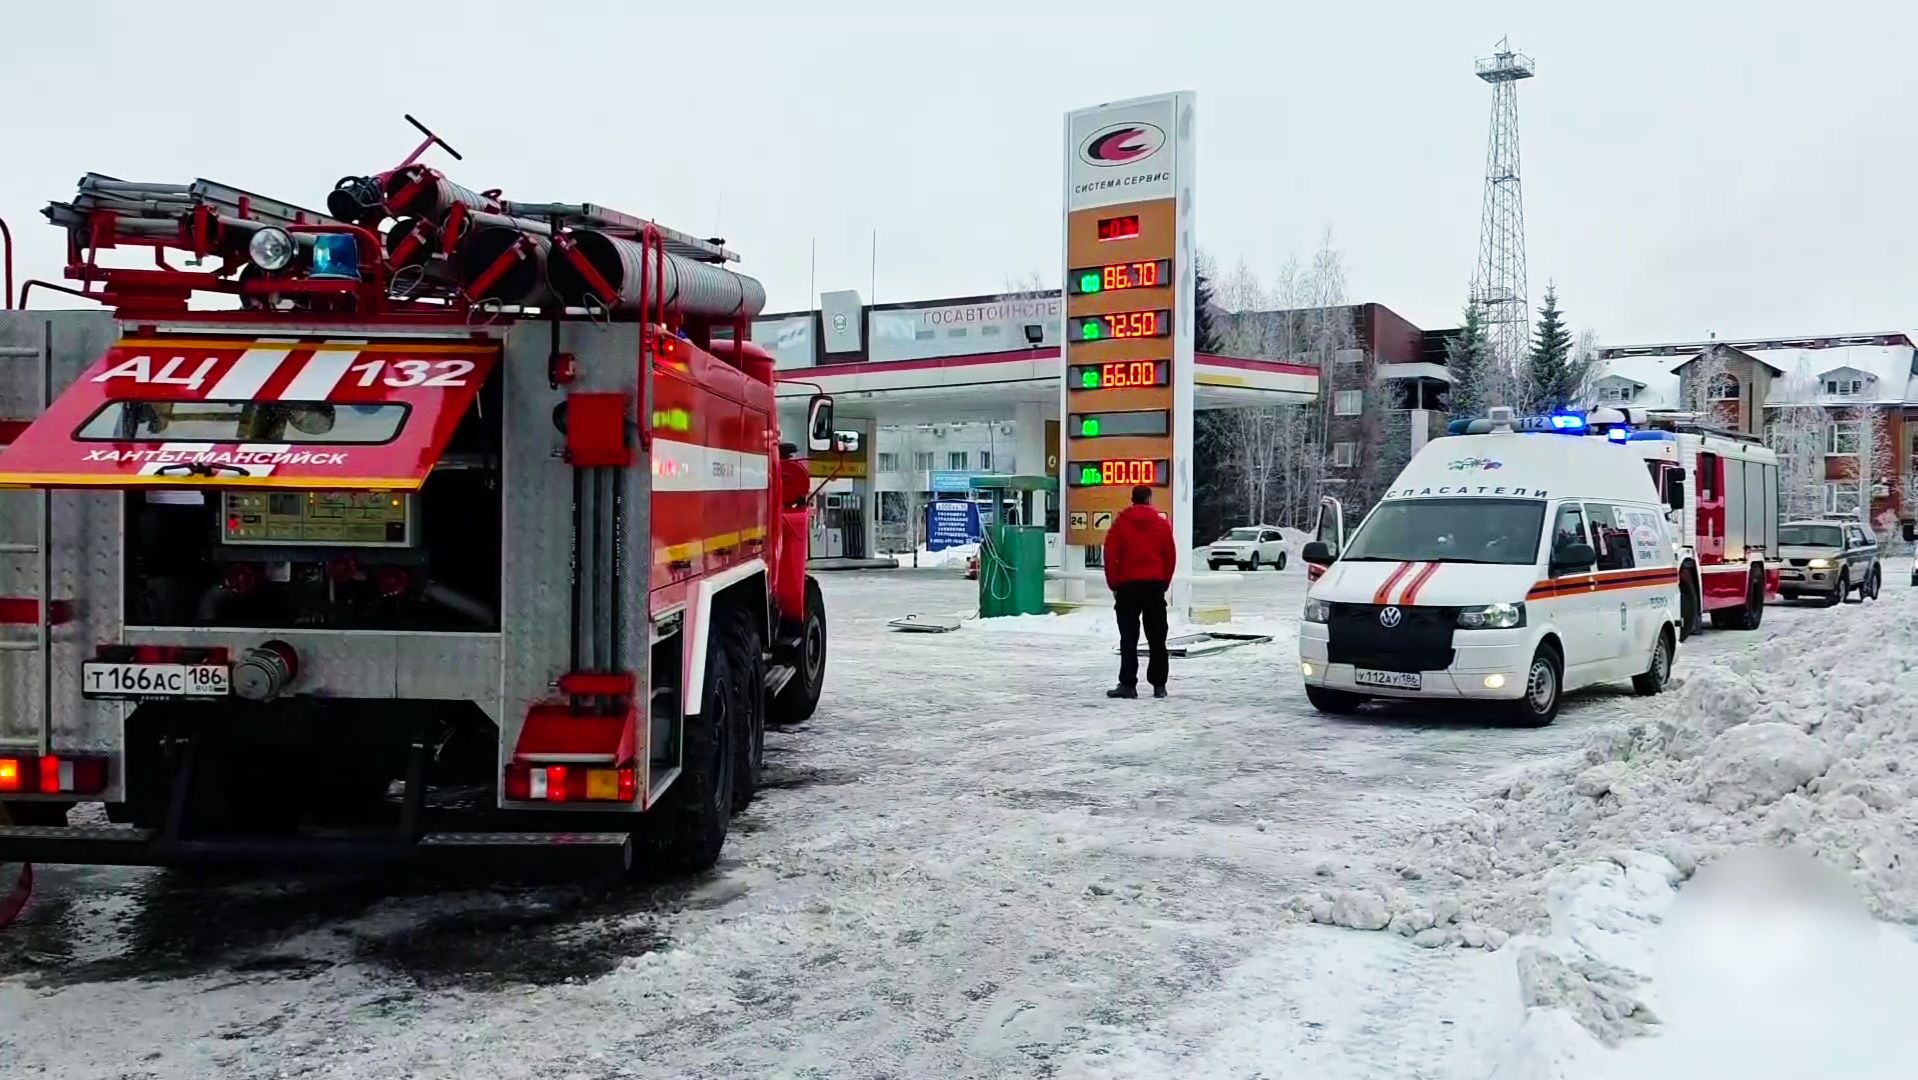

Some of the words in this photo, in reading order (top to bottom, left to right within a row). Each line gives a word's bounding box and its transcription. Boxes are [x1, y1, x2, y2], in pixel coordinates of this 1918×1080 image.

[1075, 178, 1121, 194] СИСТЕМА
[1123, 172, 1170, 187] СЕРВИС
[1103, 262, 1155, 290] 86.70
[1104, 312, 1155, 338] 72.50
[91, 355, 219, 390] АЦ
[350, 359, 476, 387] 132
[1103, 362, 1154, 387] 66.00
[1519, 417, 1544, 429] 112
[82, 448, 348, 467] ХАНТЫ-МАНСИЙСК
[1102, 460, 1154, 485] 80.00
[1386, 486, 1550, 498] СПАСАТЕЛИ
[188, 667, 223, 686] 186
